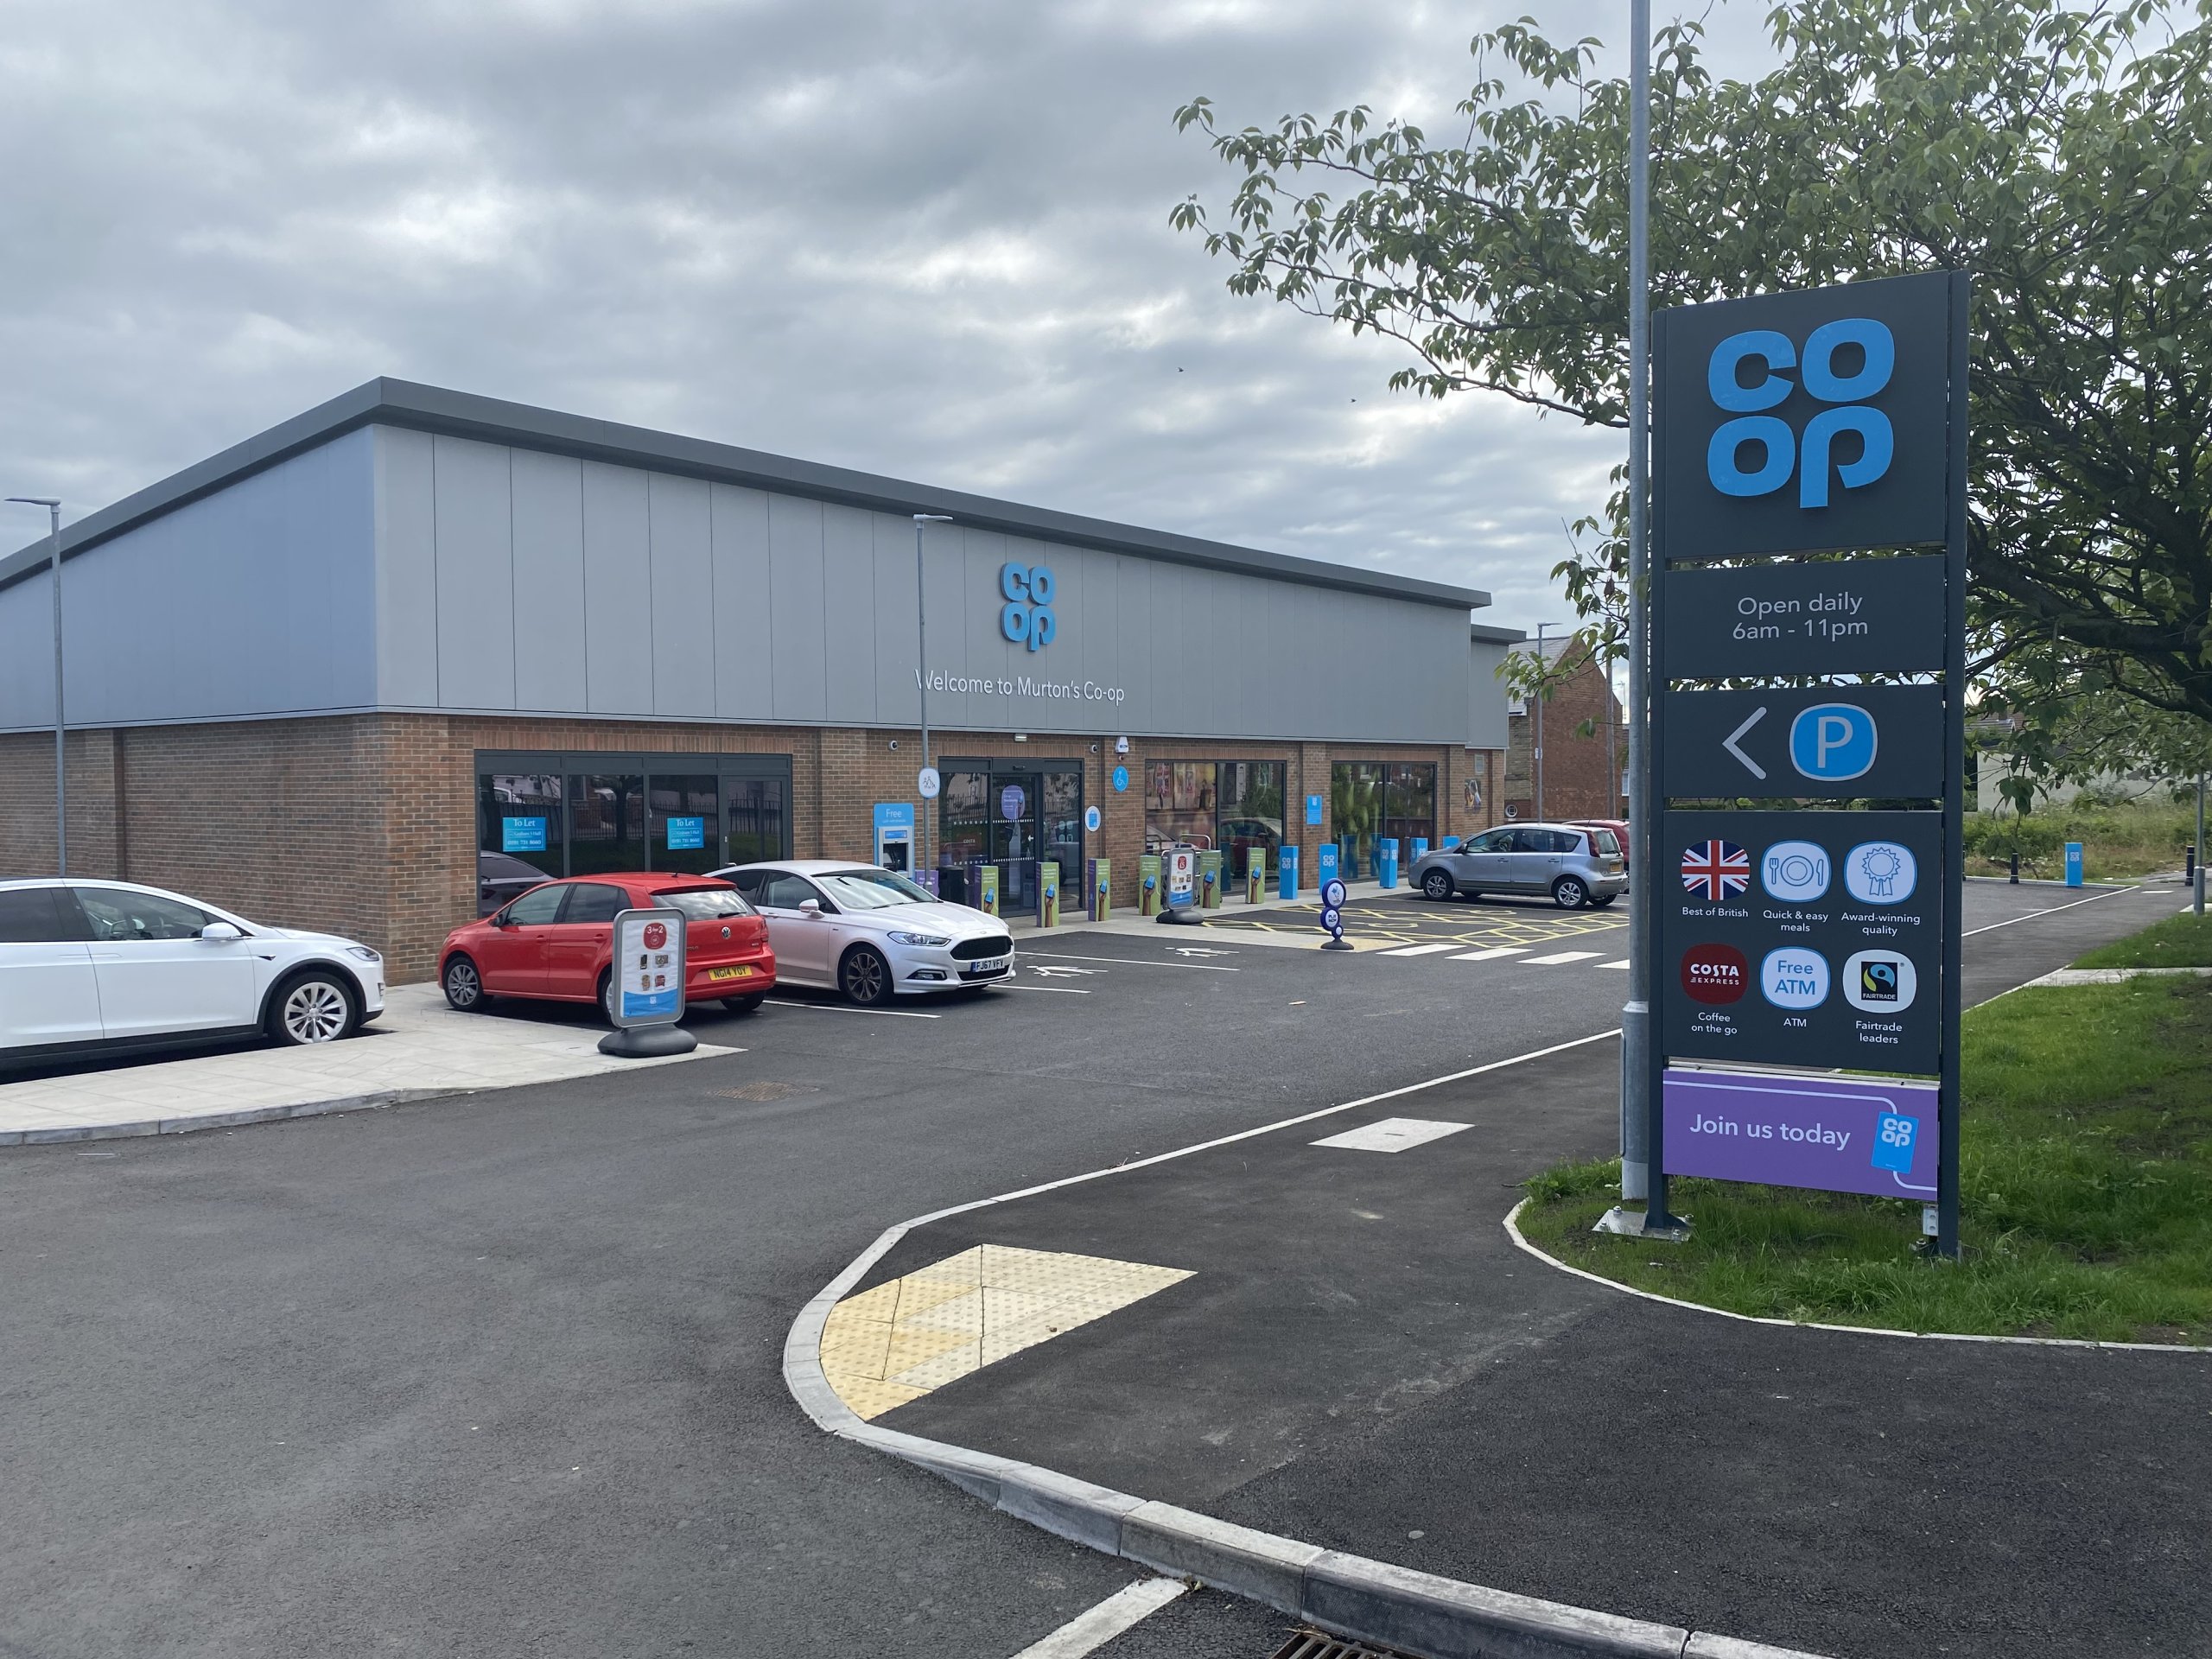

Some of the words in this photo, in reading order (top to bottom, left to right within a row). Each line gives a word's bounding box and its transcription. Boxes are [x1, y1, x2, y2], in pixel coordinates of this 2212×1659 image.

[1737, 596, 1801, 620] Open
[1808, 591, 1863, 615] daily
[1732, 622, 1780, 640] 6am
[1804, 618, 1868, 642] 11pm
[914, 669, 993, 694] Welcome
[997, 677, 1013, 696] to
[1084, 681, 1125, 706] Co-op
[1817, 715, 1854, 769] P
[886, 808, 902, 817] Free
[512, 818, 523, 827] To
[524, 818, 536, 827] Let
[676, 818, 683, 827] To
[1682, 906, 1703, 916] Best
[1706, 907, 1716, 916] of
[1718, 908, 1749, 918] British
[1763, 910, 1793, 919] Quick
[1795, 911, 1803, 919] &
[1805, 912, 1828, 923] easy
[1840, 912, 1921, 925] Award-winning
[1780, 923, 1810, 932] meals
[1862, 925, 1897, 937] quality
[1690, 963, 1739, 976] COSTA
[1777, 960, 1814, 975] Free
[1774, 979, 1815, 995] ATM
[1698, 1012, 1731, 1022] Coffee
[1783, 1018, 1807, 1027] ATM
[1706, 1024, 1722, 1033] the
[1724, 1027, 1738, 1036] go
[1855, 1020, 1903, 1032] Fairtrade
[1859, 1033, 1898, 1044] leaders
[1689, 1114, 1738, 1136] Join
[1746, 1122, 1773, 1139] us
[1779, 1122, 1851, 1151] today
